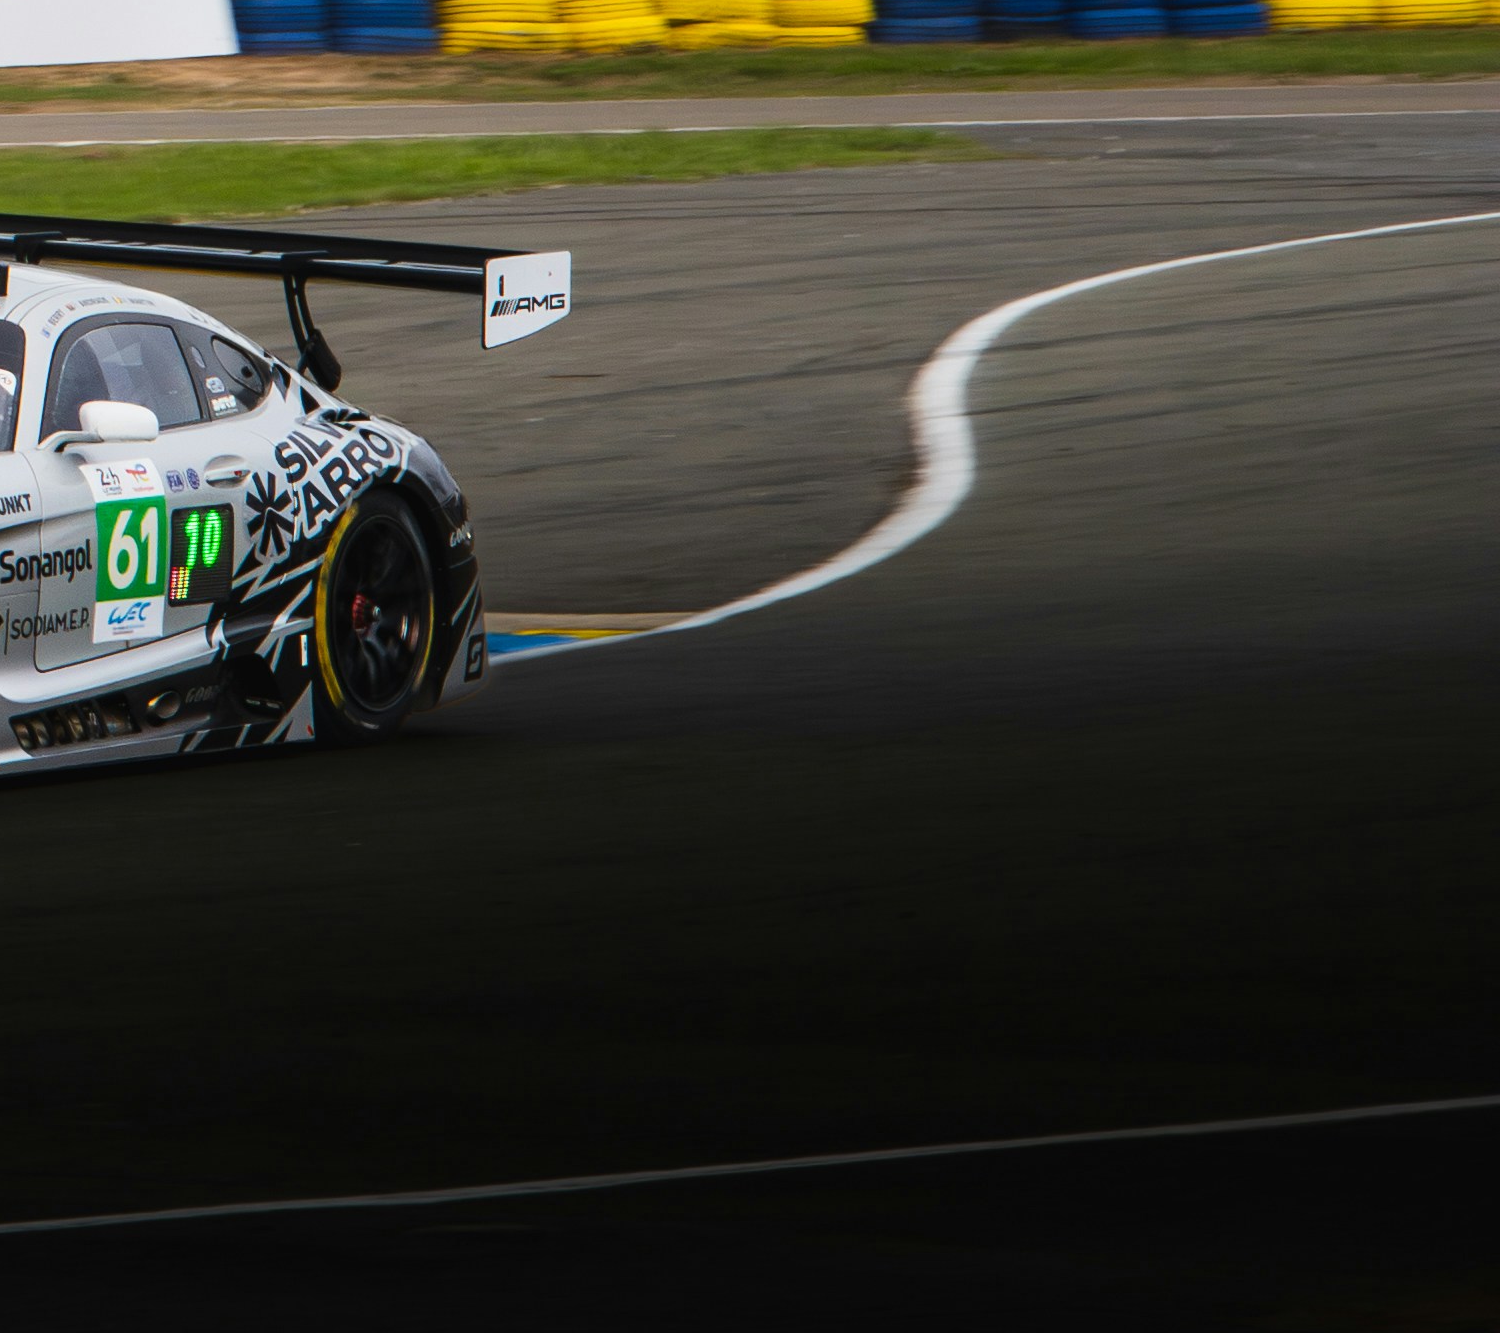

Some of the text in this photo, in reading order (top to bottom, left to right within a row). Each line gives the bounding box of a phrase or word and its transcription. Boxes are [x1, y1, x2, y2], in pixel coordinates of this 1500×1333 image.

[513, 293, 566, 314] AMG
[274, 421, 345, 484] SILV
[302, 428, 395, 531] ARRO
[0, 538, 93, 585] Sonangol
[107, 506, 159, 590] 61
[185, 509, 223, 569] 10
[107, 600, 152, 625] WEC
